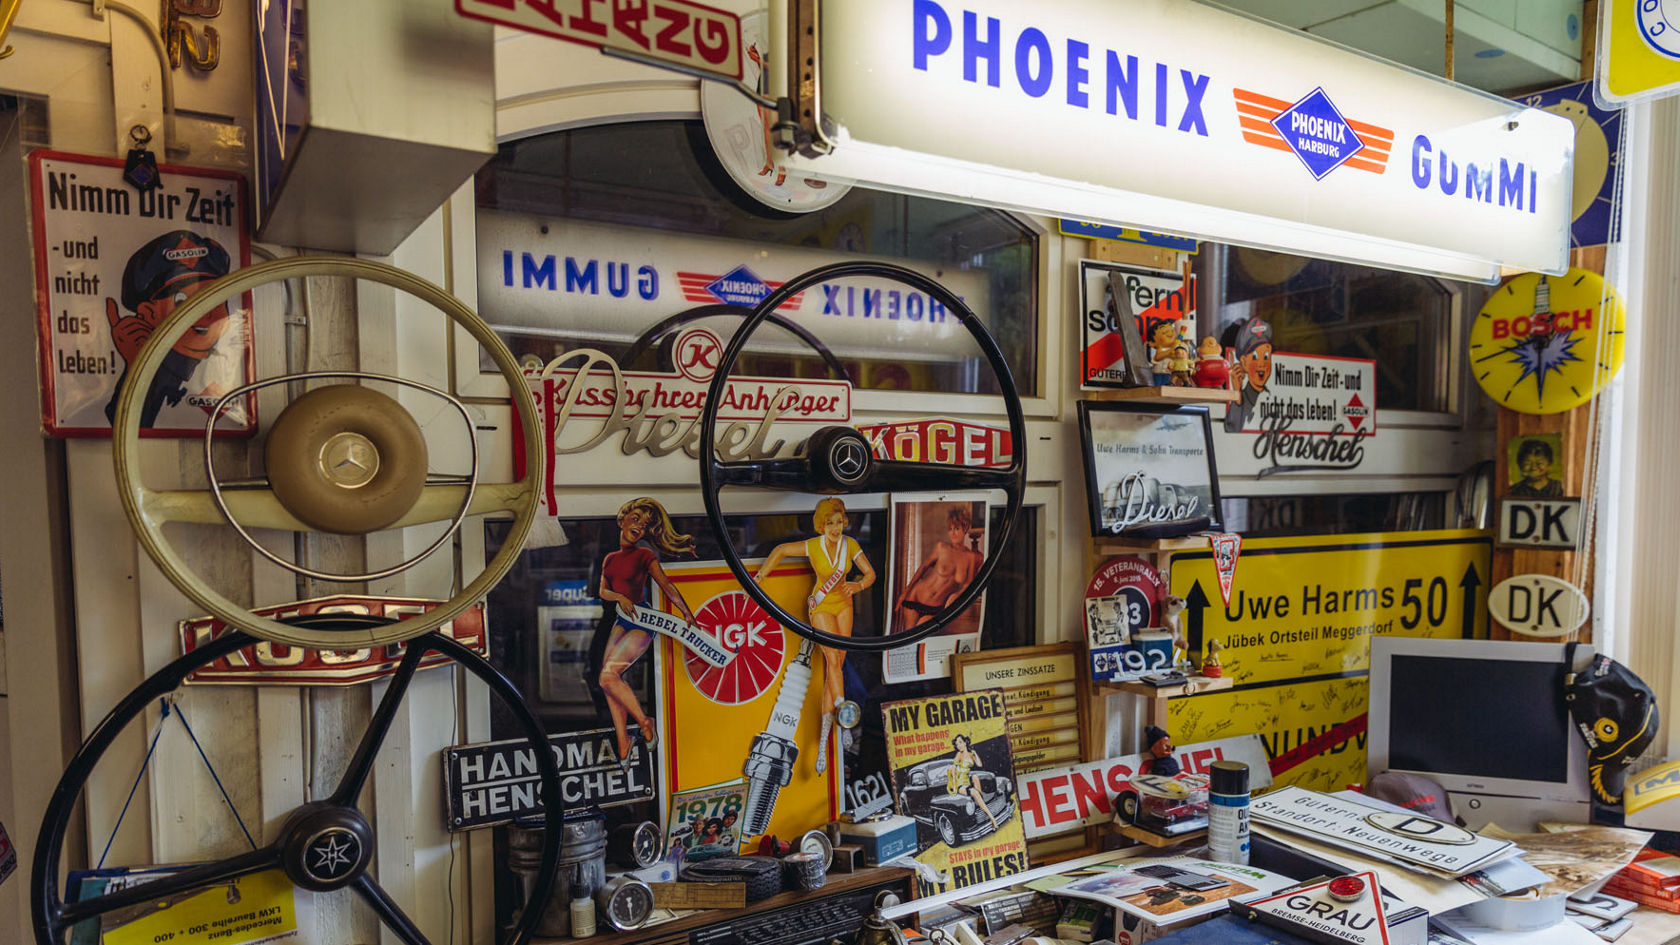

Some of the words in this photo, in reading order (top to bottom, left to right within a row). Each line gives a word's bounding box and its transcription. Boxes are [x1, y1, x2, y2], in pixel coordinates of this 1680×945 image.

[912, 0, 1210, 138] PHOENIX
[1290, 111, 1346, 145] PHOENIX
[1297, 138, 1340, 159] HARBURG
[1410, 134, 1538, 214] GUMMI
[48, 171, 130, 216] Nimm
[184, 186, 235, 227] Zeit
[55, 271, 100, 296] nicht
[58, 310, 90, 335] das
[1491, 308, 1593, 340] BOSCH
[684, 343, 717, 370] K
[1275, 363, 1303, 387] Nimm
[1305, 366, 1320, 388] Dir
[1260, 396, 1284, 419] nicht
[1287, 397, 1304, 420] das
[863, 422, 1013, 466] KÖGEL
[1096, 443, 1113, 454] Uwe
[1115, 444, 1140, 455] Harms
[1253, 412, 1367, 475] Henschel
[1508, 505, 1571, 542] DK
[819, 569, 844, 596] VEEDOL
[1224, 590, 1290, 622] Uwe
[1302, 584, 1395, 616] Harms
[1400, 576, 1448, 630] 50
[1508, 585, 1565, 628] DK
[639, 611, 679, 635] REBEL
[678, 626, 728, 666] TRUCKER
[1223, 633, 1265, 650] Jübek
[1270, 628, 1319, 645] Ortsteil
[1322, 620, 1394, 643] Meggerdorf
[985, 668, 1014, 681] UNSERE
[773, 711, 798, 727] NGK
[889, 705, 920, 733] MY
[925, 694, 1003, 728] GARAGE
[893, 733, 914, 746] What
[916, 729, 950, 745] happens
[894, 746, 903, 758] in
[904, 744, 918, 757] my
[676, 793, 743, 824] 1978
[1392, 817, 1444, 835] D
[949, 850, 972, 865] STAYS
[974, 848, 982, 859] in
[983, 845, 994, 859] my
[1344, 825, 1461, 866] Neuenwege
[952, 851, 1026, 890] RULES!
[211, 911, 256, 929] Baureihe
[258, 905, 282, 919] LKW
[1270, 907, 1367, 945] BREMSE-HEIDELBERG
[1286, 894, 1377, 932] GRAU
[153, 931, 176, 944] 400
[188, 922, 208, 936] 300
[207, 916, 283, 941] Mercedes-Benz
